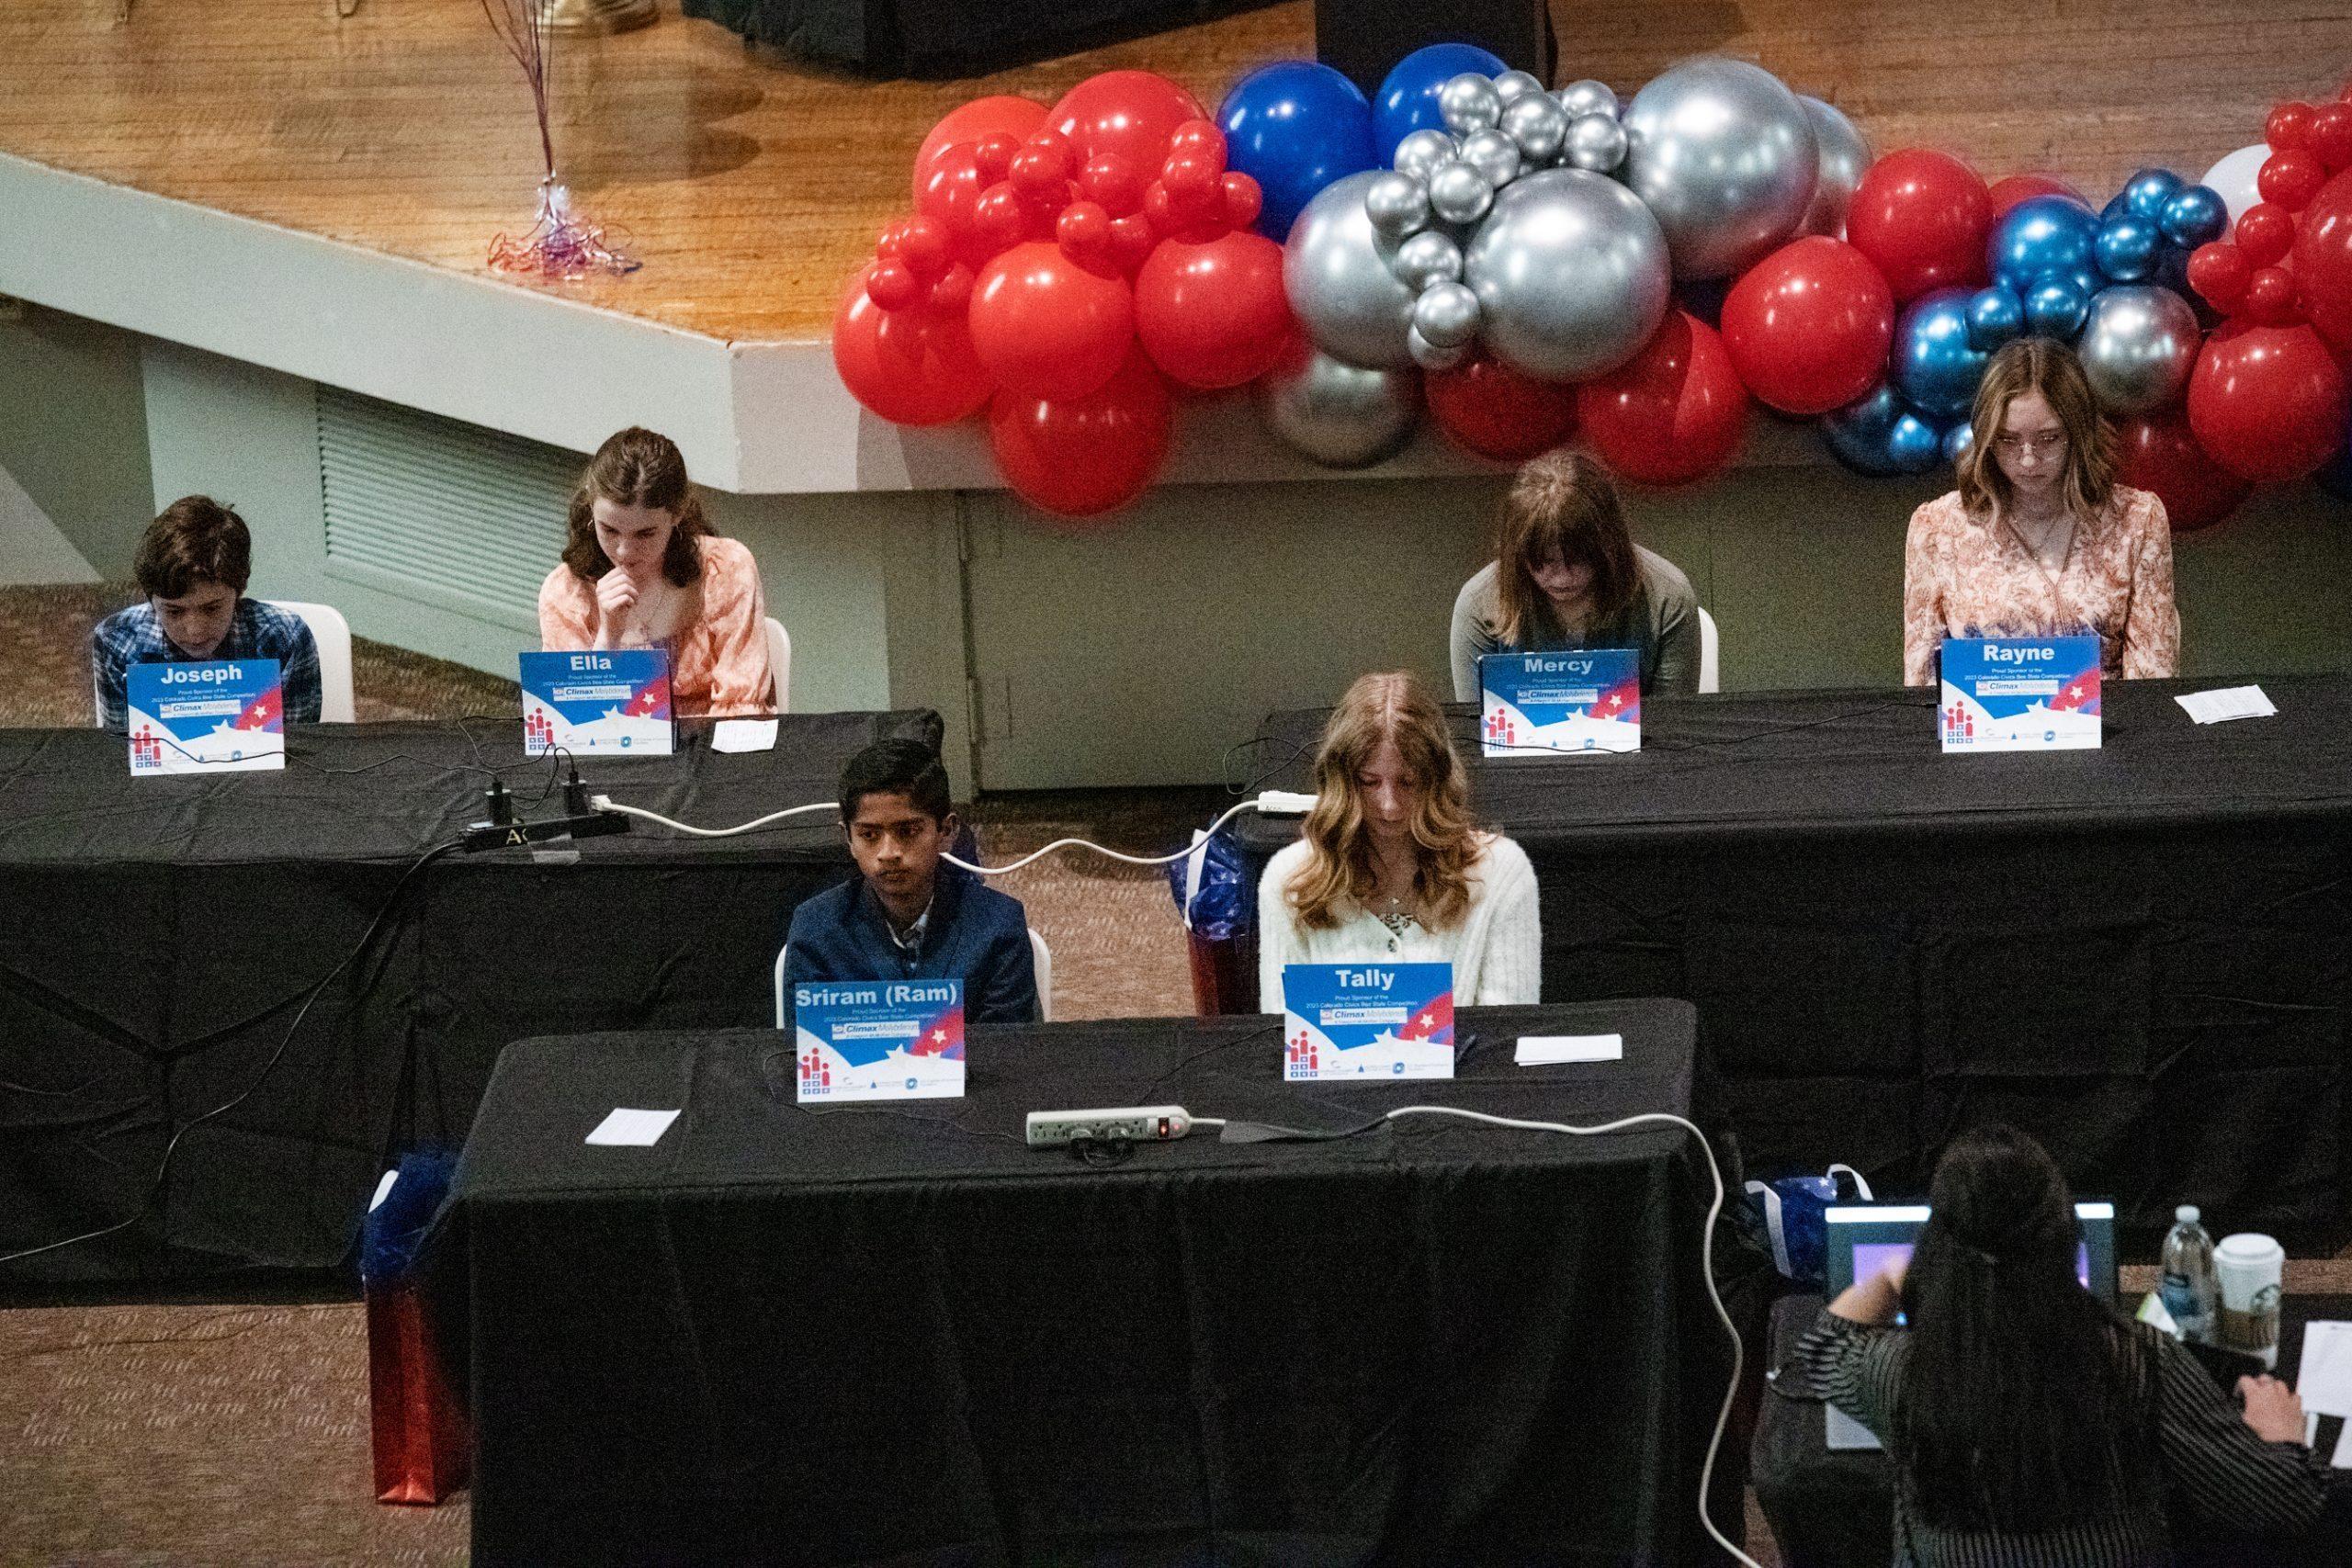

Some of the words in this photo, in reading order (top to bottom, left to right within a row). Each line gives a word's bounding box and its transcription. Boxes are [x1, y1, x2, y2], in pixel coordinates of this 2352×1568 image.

[1984, 644, 2055, 664] Rayne
[570, 655, 612, 671] Ella
[1524, 659, 1593, 674] Mercy
[161, 664, 243, 684] Joseph
[1990, 682, 2019, 690] Climax
[173, 703, 202, 712] Climax
[1335, 969, 1395, 990] Tally
[797, 988, 876, 1007] Sriram
[886, 983, 956, 1007] (Ram)
[1334, 1010, 1365, 1019] Climax
[846, 1024, 877, 1033] Climax
